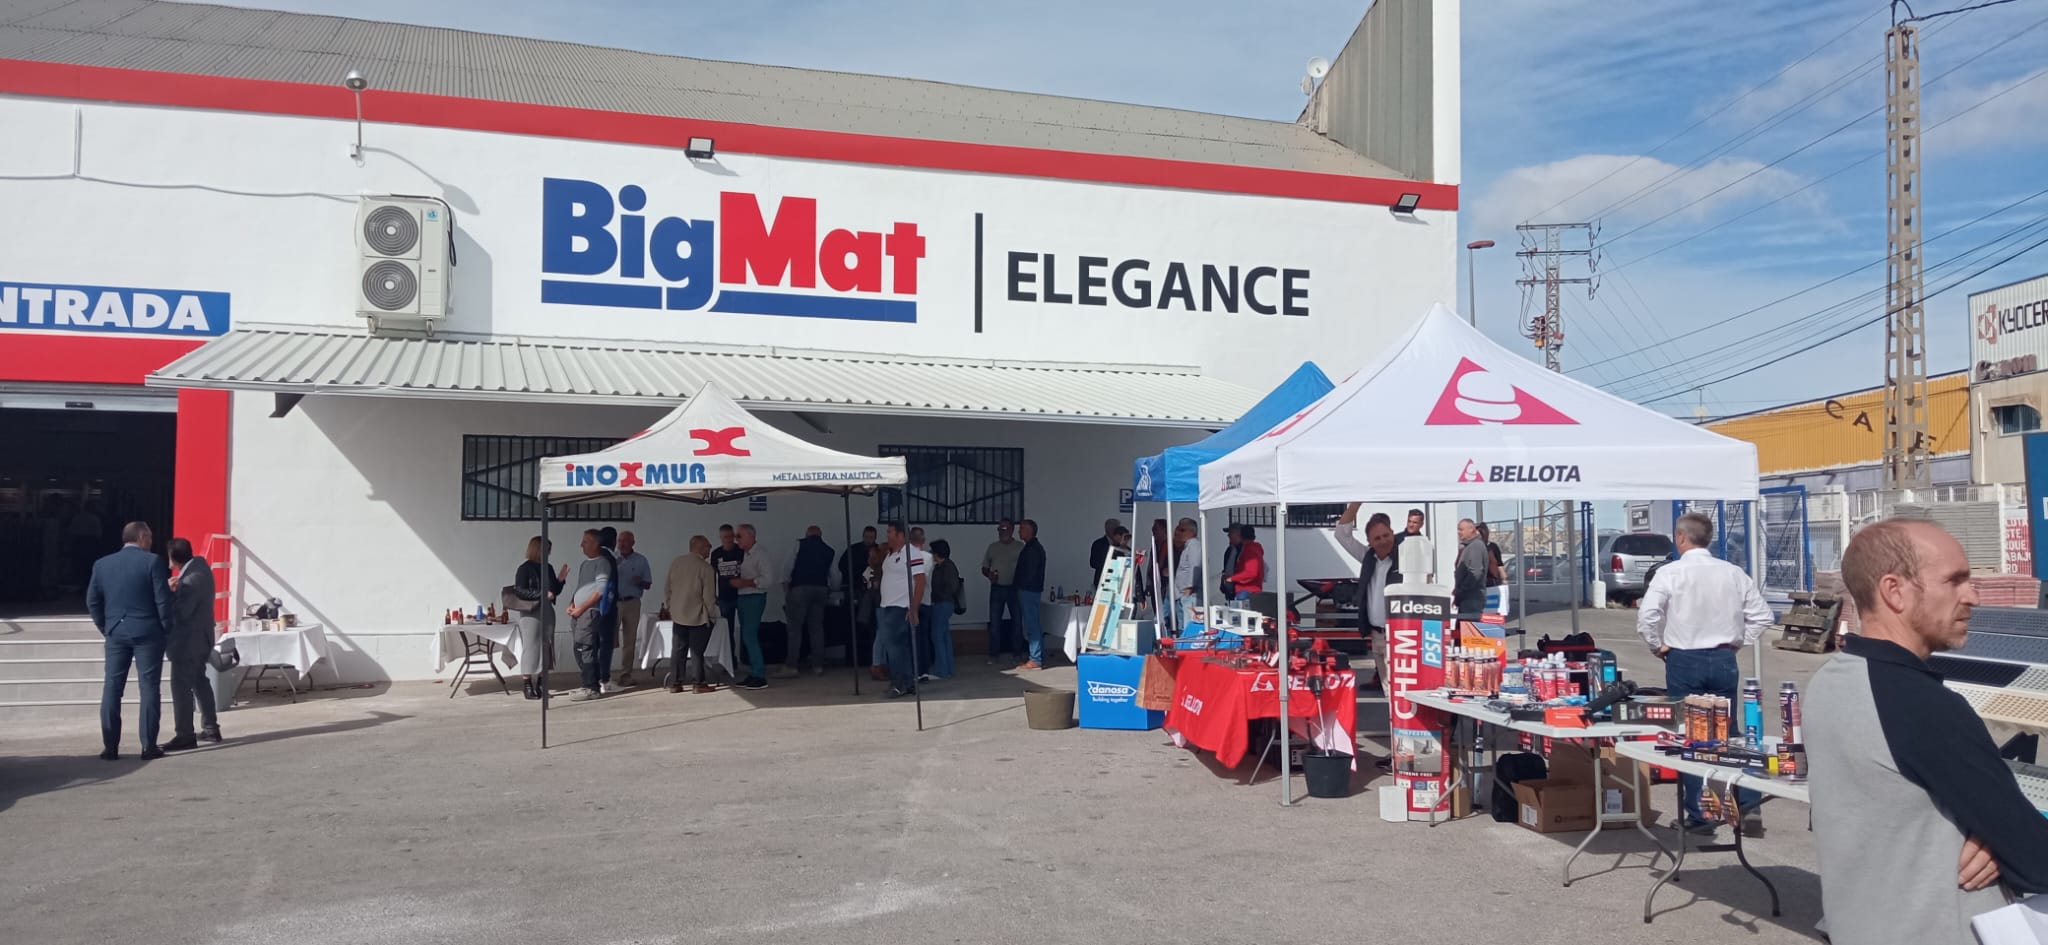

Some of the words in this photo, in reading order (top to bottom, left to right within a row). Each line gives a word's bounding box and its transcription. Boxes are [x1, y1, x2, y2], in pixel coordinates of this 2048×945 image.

[541, 177, 926, 312] BigMat
[1007, 251, 1310, 316] ELEGANCE
[772, 472, 839, 481] METALISTERIA
[1488, 464, 1582, 483] BELLOTA
[1121, 489, 1133, 504] P
[1402, 601, 1443, 615] desa
[1424, 630, 1442, 665] PSF
[1393, 629, 1418, 720] CHEM
[1091, 682, 1130, 694] danosa
